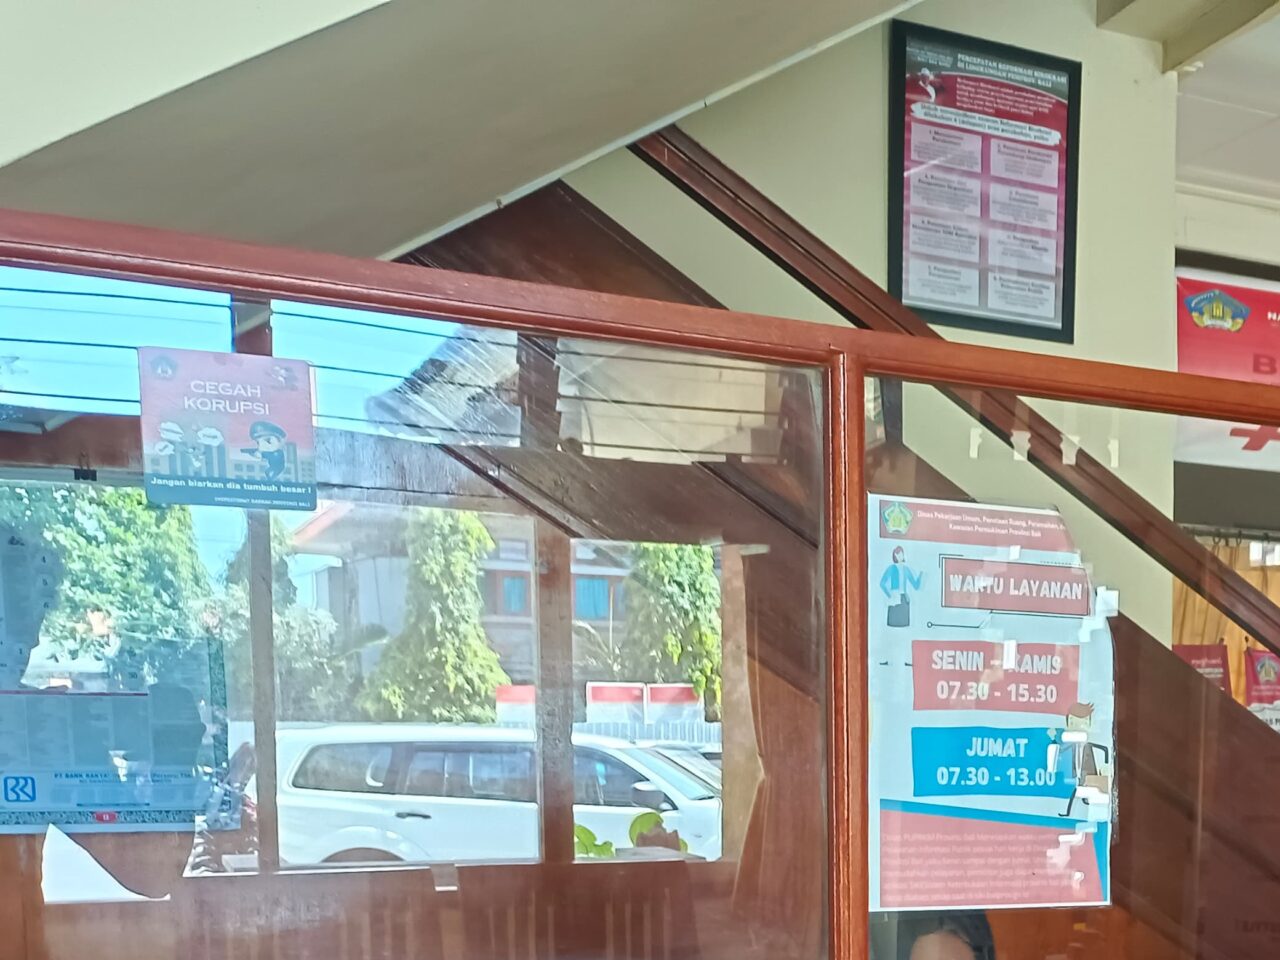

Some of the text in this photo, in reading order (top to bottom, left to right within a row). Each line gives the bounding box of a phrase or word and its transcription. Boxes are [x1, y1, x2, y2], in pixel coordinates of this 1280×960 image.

[190, 380, 261, 397] CEGAH
[184, 396, 270, 415] KORUPSI
[151, 477, 186, 488] Jangan
[188, 480, 224, 490] biarkan
[226, 481, 241, 490] dia
[243, 482, 278, 492] tumbuh
[280, 485, 306, 494] besar
[949, 574, 1082, 600] WAKTU LAYANAN
[931, 650, 984, 671] SENIN
[936, 681, 989, 701] 07.30
[1007, 684, 1057, 703] 15.30
[966, 736, 1029, 758] JUMAT
[936, 767, 989, 786] 07.30
[1006, 768, 1056, 786] 13.00
